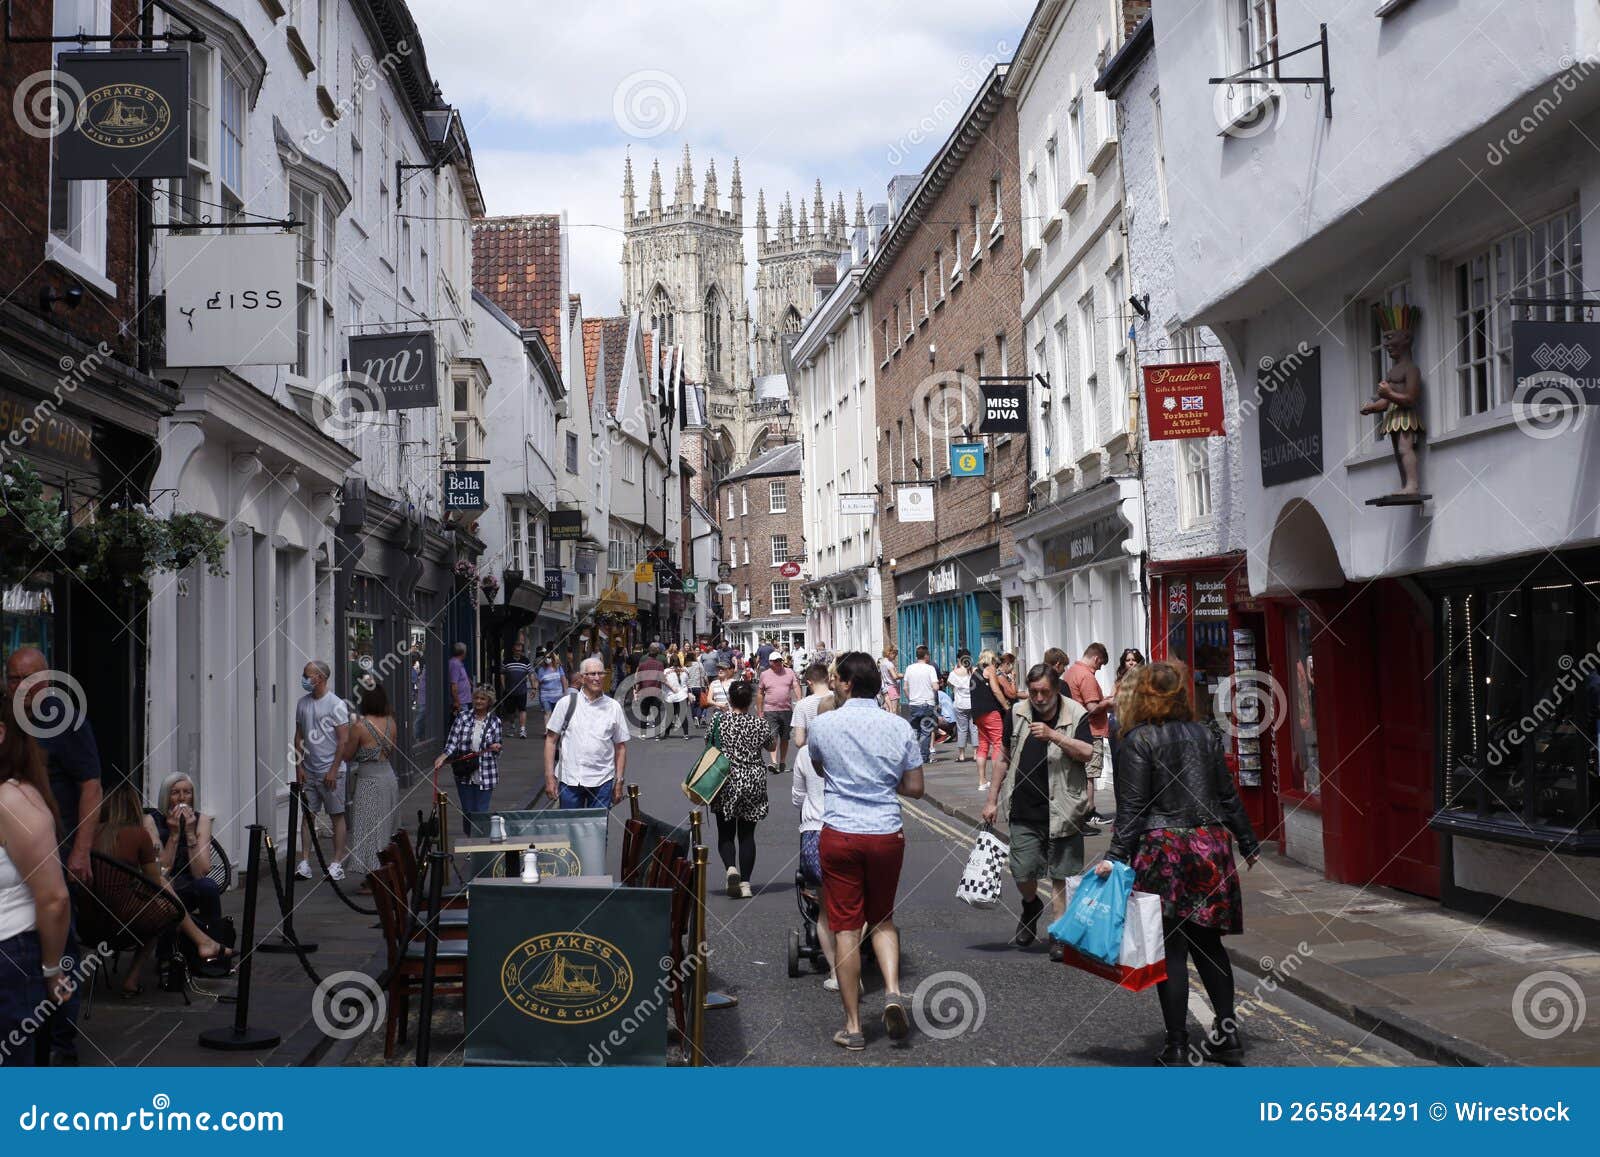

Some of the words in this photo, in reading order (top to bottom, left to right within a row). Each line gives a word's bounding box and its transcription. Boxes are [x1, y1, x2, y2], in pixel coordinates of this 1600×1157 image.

[92, 87, 156, 103] DRAKE'S
[87, 127, 111, 142] FISH
[129, 126, 160, 143] CHIPS
[1151, 368, 1211, 384] Pandora
[391, 383, 426, 392] VELVET
[1517, 376, 1600, 388] SILVARIOU
[987, 398, 1020, 408] MISS
[987, 409, 1019, 420] DIVA
[1163, 411, 1209, 420] Yorkshire
[1180, 419, 1201, 427] York
[1163, 427, 1211, 436] souvenirs
[1261, 434, 1319, 468] SILVARIOUS
[449, 477, 481, 490] Bella
[448, 492, 481, 505] Italia
[1195, 581, 1227, 590] Yorkshire
[1208, 594, 1223, 603] York
[1195, 607, 1229, 616] souvenirs
[523, 936, 613, 959] DRAKE'S
[515, 993, 550, 1016] FISH
[557, 1009, 567, 1018] &
[574, 995, 619, 1018] CHIPS
